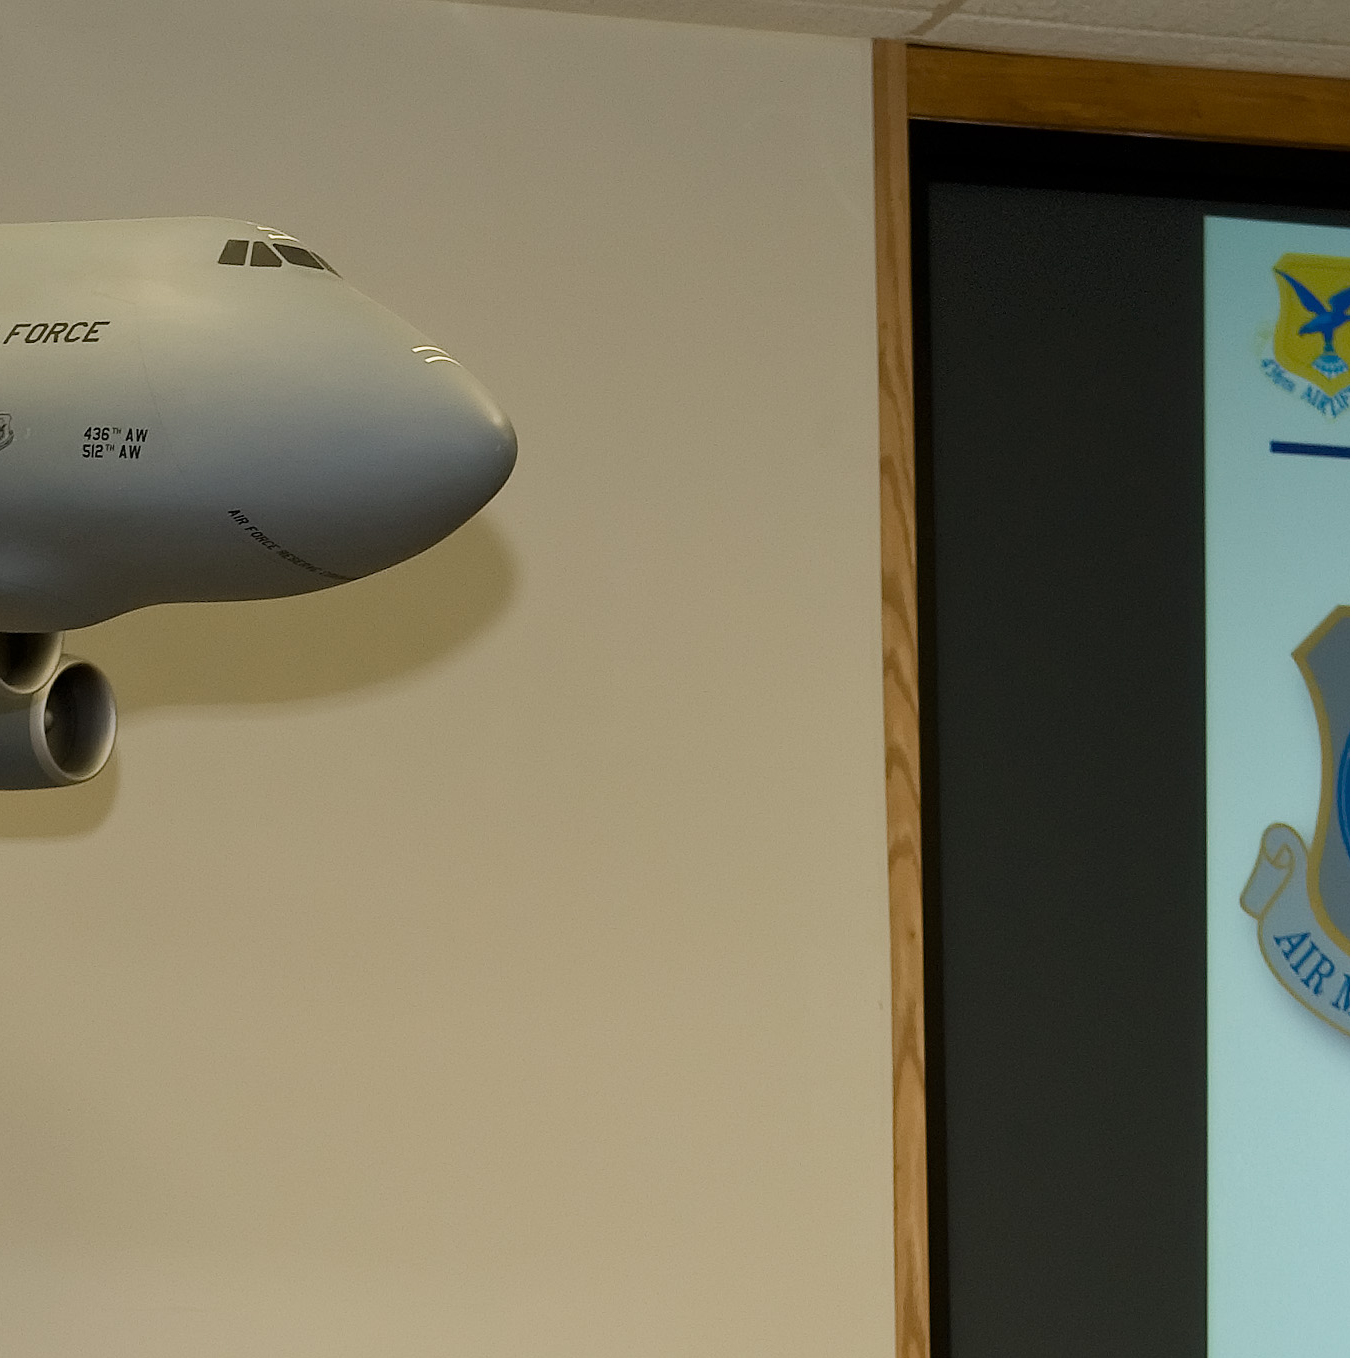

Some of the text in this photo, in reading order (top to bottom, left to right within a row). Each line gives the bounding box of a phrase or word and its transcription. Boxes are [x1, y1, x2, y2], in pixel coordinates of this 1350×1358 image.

[3, 321, 111, 345] FORCE
[125, 427, 149, 443] AW
[119, 444, 142, 459] AW
[228, 509, 250, 526] AIR
[244, 525, 281, 551] FORCE
[1273, 931, 1336, 996] AIR
